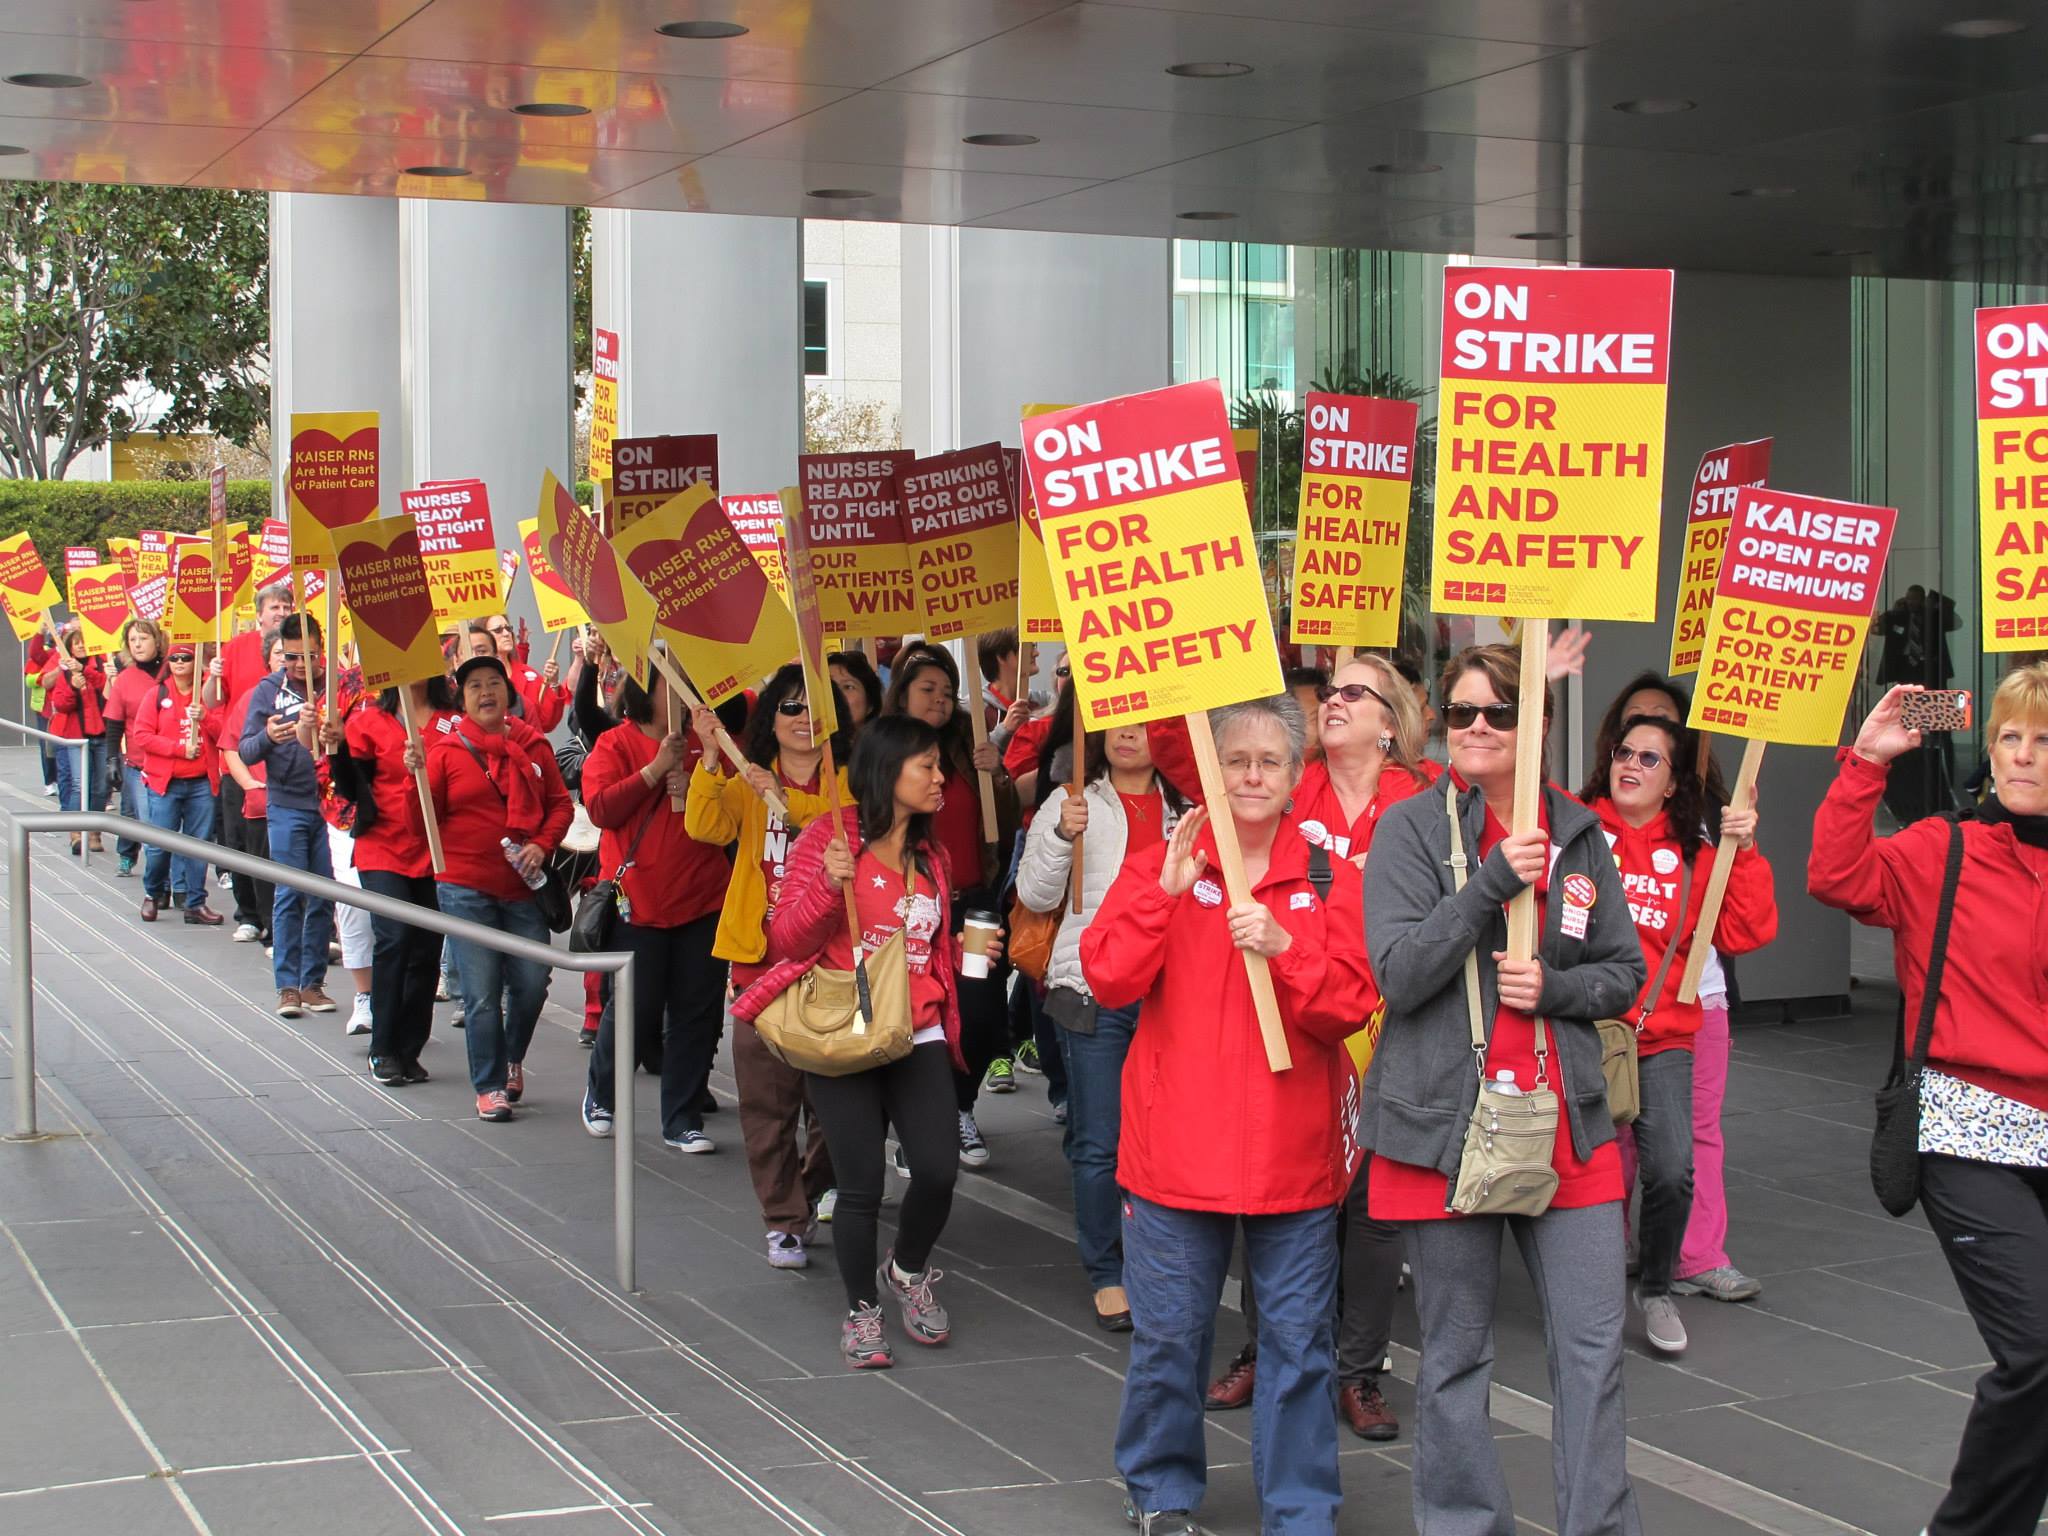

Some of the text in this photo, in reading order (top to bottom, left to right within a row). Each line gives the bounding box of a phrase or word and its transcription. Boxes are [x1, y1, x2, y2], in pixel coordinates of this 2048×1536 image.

[1454, 283, 1528, 322] ON
[597, 336, 608, 354] ON
[1452, 329, 1655, 374] STRIKE
[1986, 321, 2048, 359] ON
[595, 356, 617, 378] STRI
[595, 384, 610, 402] FOR
[594, 405, 616, 425] HEAL
[1310, 405, 1350, 432] ON
[1452, 392, 1557, 430] FOR
[592, 424, 609, 443] AND
[1033, 420, 1102, 462] ON
[1993, 428, 2048, 465] FO
[295, 449, 375, 463] KAISER RNs
[590, 445, 612, 465] SAFE
[617, 446, 653, 466] ON
[1308, 438, 1407, 474] STRIKE
[1451, 438, 1648, 478] HEALTH
[295, 464, 375, 477] Are the Heart
[618, 465, 712, 492] STRIKE
[807, 460, 893, 480] NURSES
[904, 458, 999, 495] STRIKING
[1043, 437, 1227, 508] STRIKE
[1700, 457, 1729, 484] ON
[295, 478, 375, 490] of Patient Care
[808, 481, 882, 500] READY
[907, 480, 1000, 514] FOR OUR
[1306, 482, 1363, 510] FOR
[406, 491, 471, 509] NURSES
[809, 503, 838, 520] TO
[1447, 485, 1559, 522] AND
[437, 518, 485, 534] FIGHT
[732, 518, 784, 530] OPEN FO
[911, 498, 1008, 534] PATIENTS
[1745, 501, 1881, 547] KAISER
[142, 533, 157, 541] ON
[742, 533, 777, 544] REMIU
[810, 522, 875, 541] UNTIL
[1056, 513, 1152, 560] FOR
[1304, 516, 1401, 546] HEALTH
[1994, 520, 2048, 556] AN
[142, 543, 167, 552] STRI
[586, 532, 600, 561] Care
[640, 526, 732, 589] KAISER RNs
[918, 542, 973, 570] AND
[1446, 530, 1645, 570] SAFETY
[1739, 537, 1870, 574] OPEN FOR
[0, 555, 21, 570] AISER
[346, 553, 419, 579] KAISER RNs
[672, 569, 697, 591] the
[699, 542, 742, 574] Heart
[811, 552, 857, 570] OUR
[1064, 535, 1245, 601] HEALTH
[1301, 548, 1362, 576] AND
[78, 586, 106, 596] KAISER
[130, 576, 167, 599] NURSES
[188, 585, 213, 593] Patient
[350, 569, 422, 593] Are the Heart
[428, 569, 494, 587] ATIENTS
[657, 605, 671, 620] of
[671, 580, 718, 612] Patient
[718, 557, 751, 581] Care
[813, 569, 914, 589] PATIENTS
[921, 565, 978, 592] OUR
[1732, 564, 1866, 601] PREMIUMS
[105, 592, 125, 600] Heart
[135, 587, 166, 607] READY
[352, 583, 426, 608] of Patient Care
[446, 582, 497, 603] WIN
[847, 588, 915, 615] WIN
[925, 579, 1018, 617] FUTURE
[1299, 582, 1396, 611] SAFETY
[1682, 588, 1714, 613] AN
[140, 603, 153, 614] TO
[1077, 597, 1174, 643] AND
[1722, 607, 1856, 647] CLOSED
[1083, 619, 1257, 684] SAFETY
[1716, 635, 1773, 662] FOR
[1780, 646, 1848, 670] SAFE
[1711, 659, 1823, 692] PATIENT
[1706, 682, 1782, 711] CARE
[1628, 903, 1668, 930] SES
